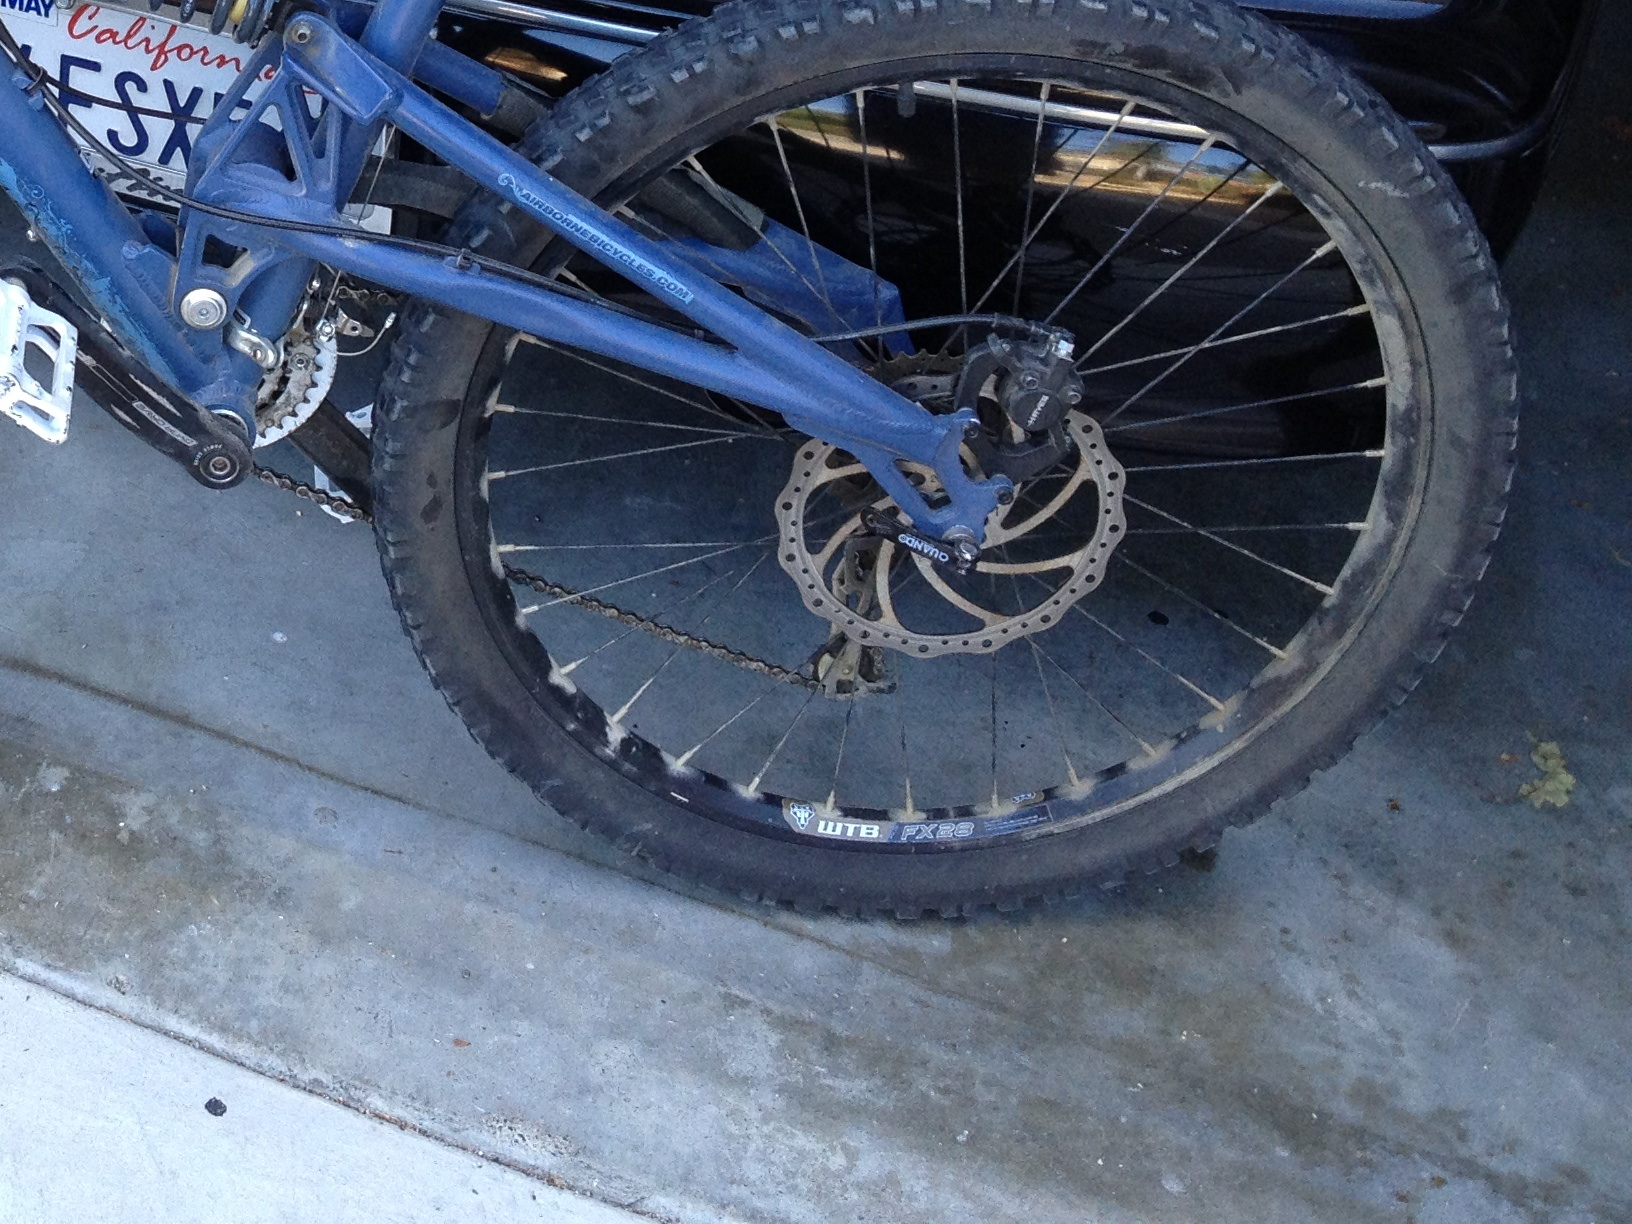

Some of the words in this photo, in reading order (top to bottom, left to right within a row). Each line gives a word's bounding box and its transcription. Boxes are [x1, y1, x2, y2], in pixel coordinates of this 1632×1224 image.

[67, 2, 276, 83] Californ
[520, 189, 694, 304] AIRBORNEBICYCLES.COM
[898, 533, 949, 563] QUANDO
[817, 819, 881, 839] WTB
[900, 821, 975, 841] FX28
